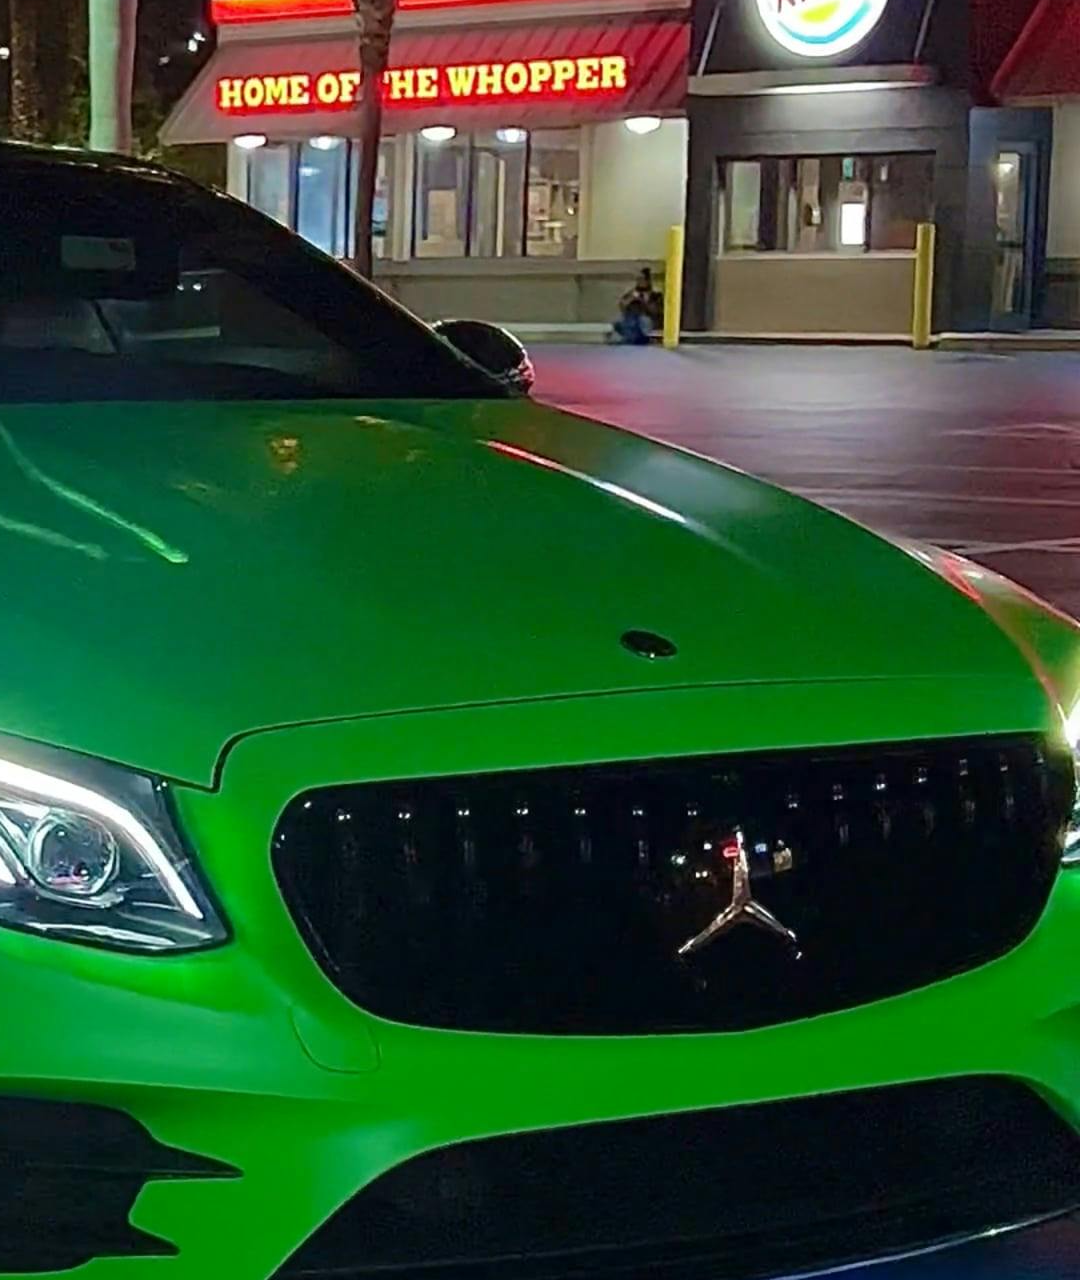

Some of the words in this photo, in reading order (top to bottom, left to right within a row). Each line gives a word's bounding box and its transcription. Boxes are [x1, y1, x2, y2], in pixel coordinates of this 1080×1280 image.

[219, 75, 310, 108] HOME
[317, 72, 361, 104] OF
[382, 67, 438, 99] HE
[446, 56, 627, 97] WHOPPER
